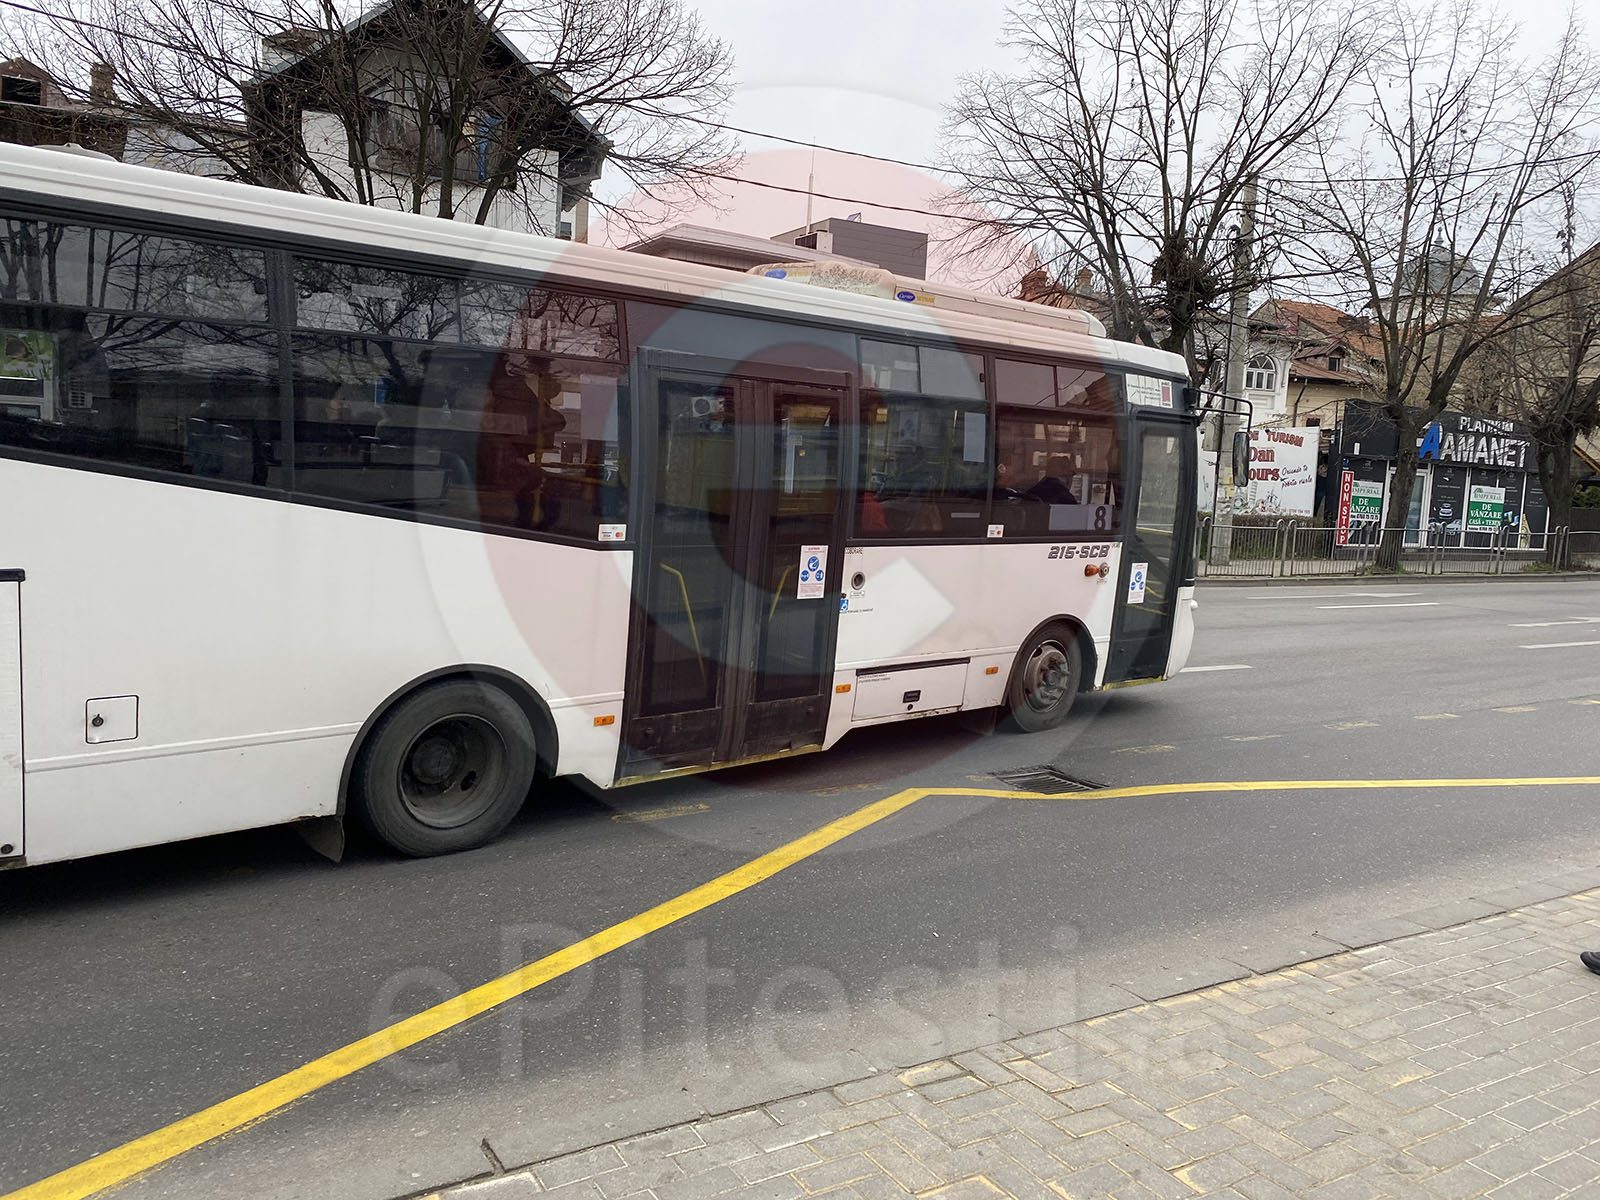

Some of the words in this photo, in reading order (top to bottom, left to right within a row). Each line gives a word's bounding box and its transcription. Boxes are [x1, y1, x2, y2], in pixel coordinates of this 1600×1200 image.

[1266, 431, 1304, 448] TURISM
[1248, 468, 1280, 481] ours
[1358, 498, 1369, 506] DE
[1482, 503, 1492, 511] DE
[1351, 503, 1380, 514] ÂNZARE
[1094, 506, 1107, 530] 8
